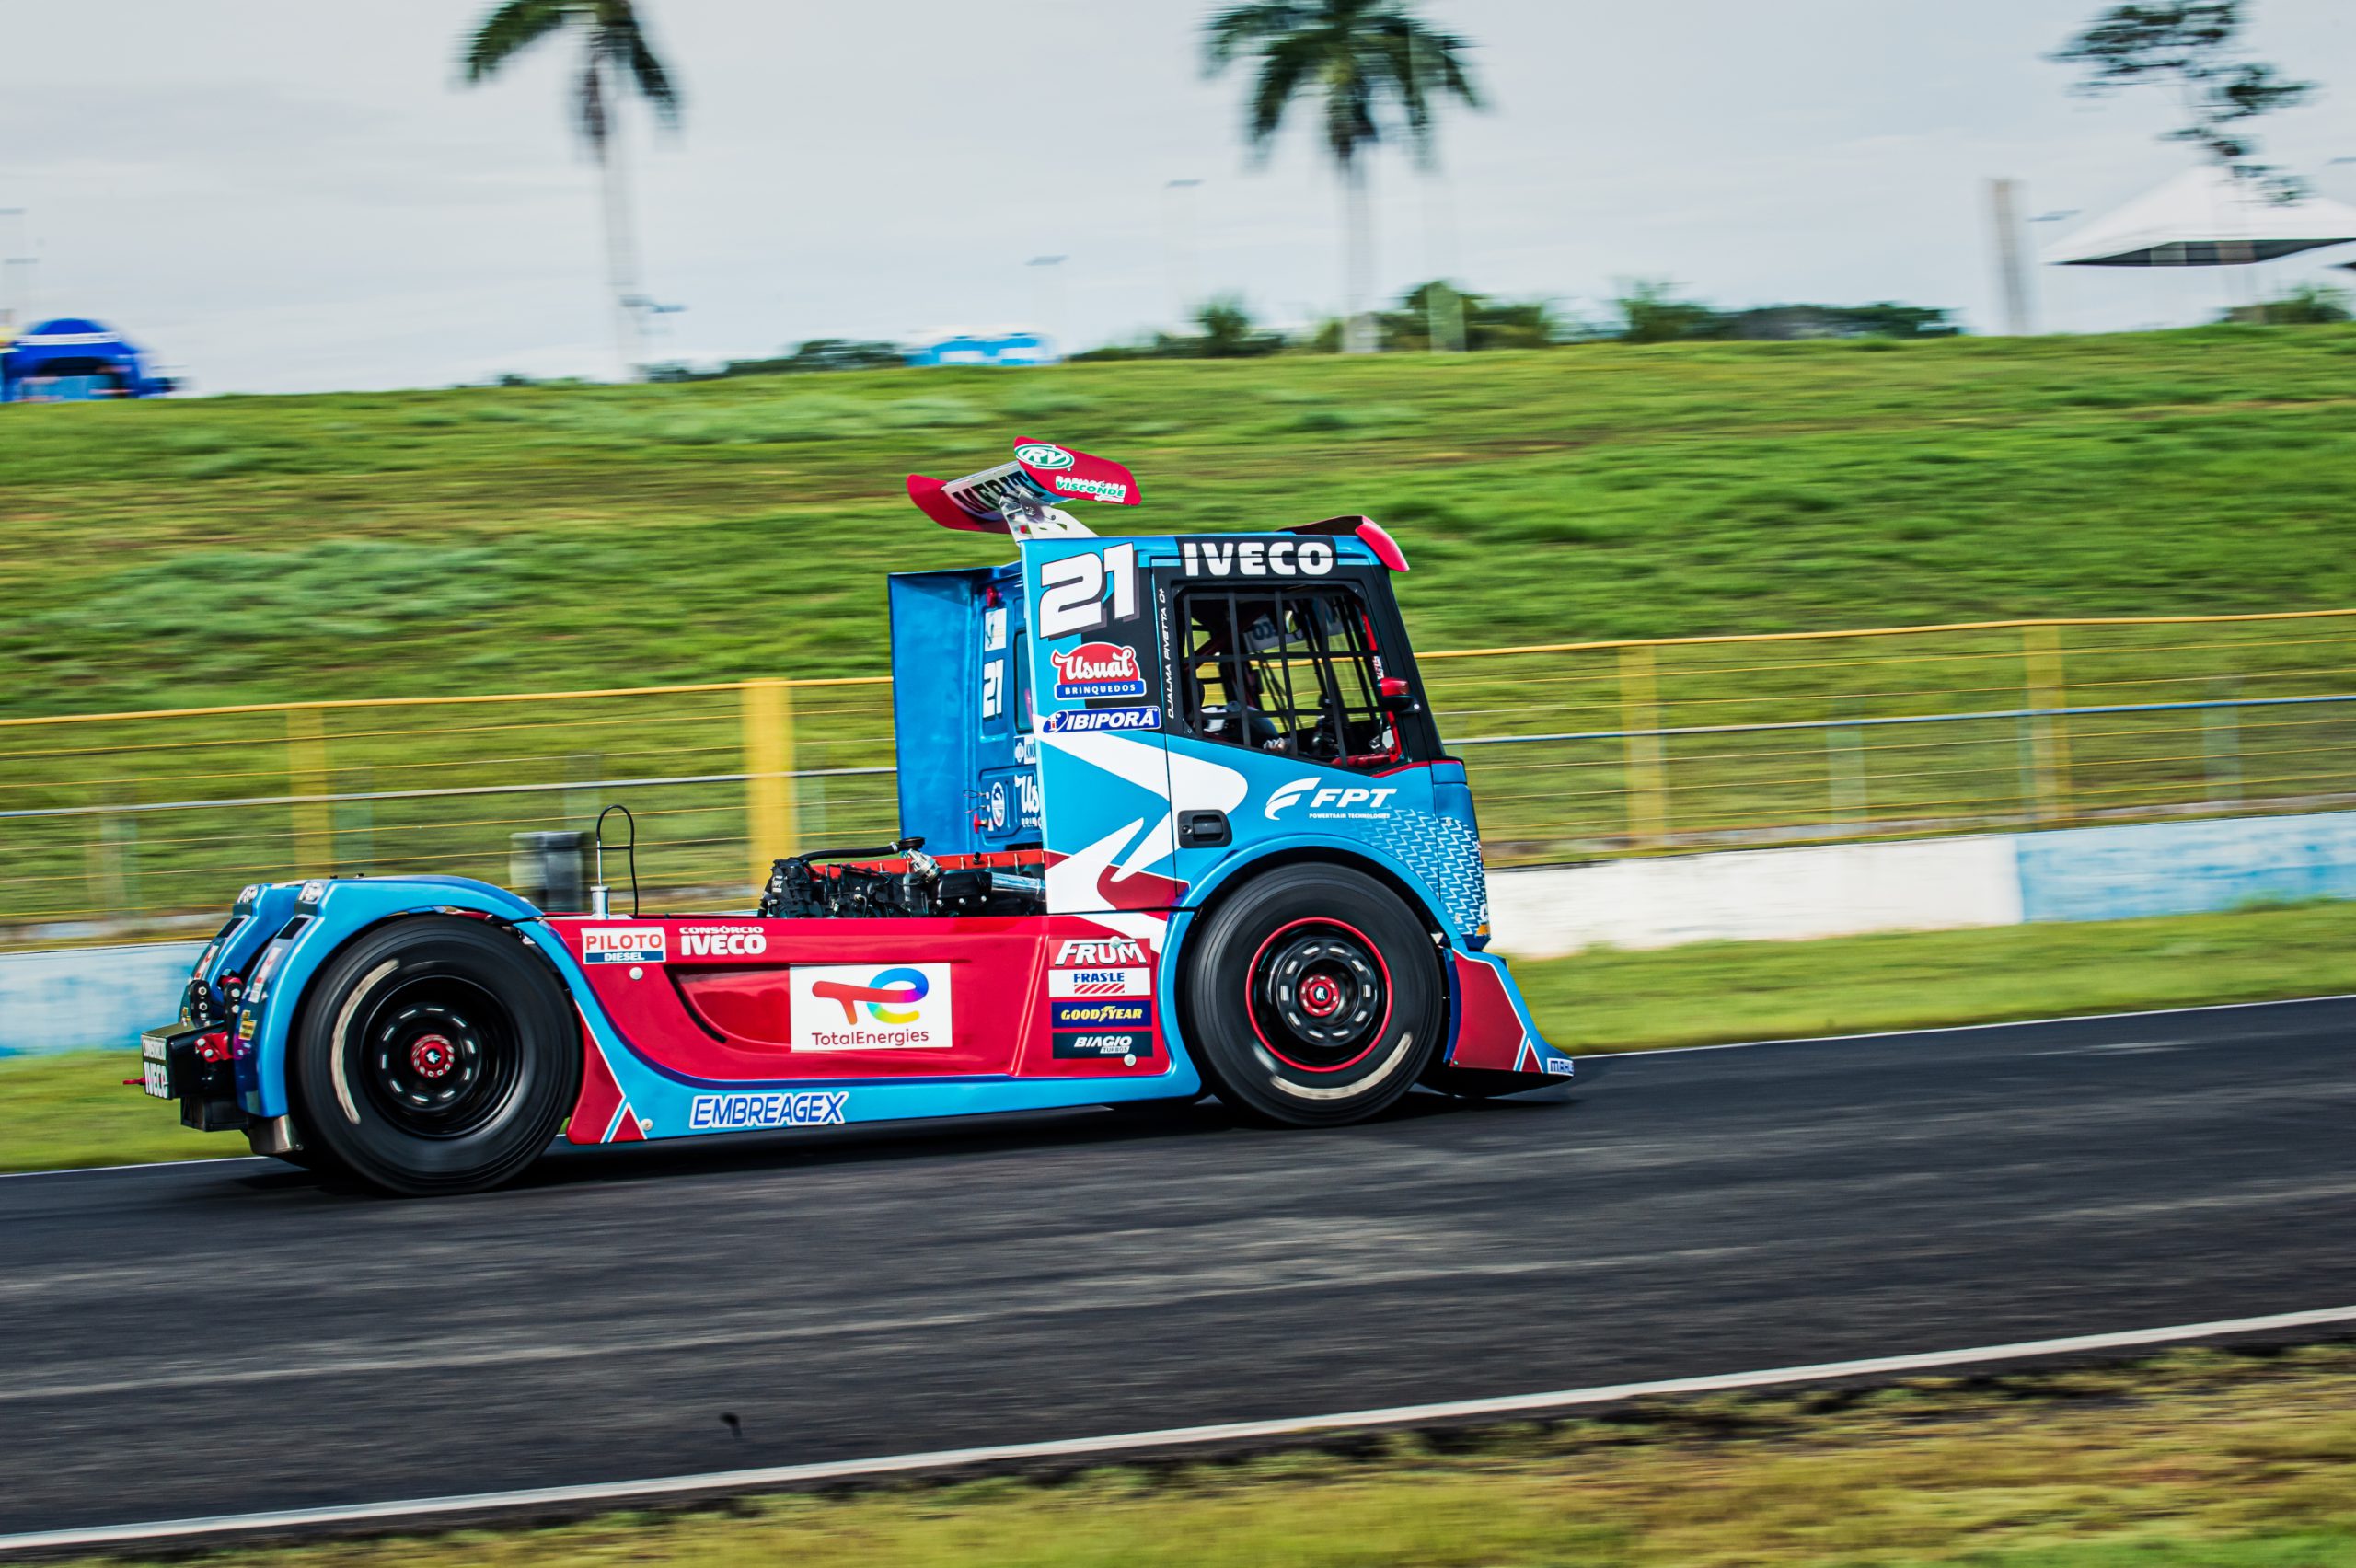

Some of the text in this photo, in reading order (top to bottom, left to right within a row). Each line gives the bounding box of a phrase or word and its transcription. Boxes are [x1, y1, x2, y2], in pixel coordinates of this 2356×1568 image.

[1022, 448, 1068, 465] RV
[952, 470, 1047, 515] MERIT
[1056, 480, 1126, 497] VISCONDE
[1184, 541, 1334, 577] IVECO
[1039, 541, 1135, 639] 21
[1160, 607, 1171, 661] PIVETTA
[1054, 649, 1134, 681] Usual
[982, 658, 1004, 719] 21
[1064, 684, 1137, 696] BRINQUEDOS
[1164, 663, 1175, 719] DJALMA
[1309, 788, 1398, 808] FPT
[679, 925, 765, 935] CONSÓRCIO
[585, 933, 664, 951] PILOTO
[680, 934, 767, 956] IVECO
[1055, 939, 1147, 966] FRUM
[604, 951, 645, 962] DIESEL
[1060, 1007, 1143, 1021] GOODYEAR
[812, 1028, 930, 1046] TotalEnergies
[1073, 1036, 1133, 1048] BIAGIO
[693, 1093, 847, 1126] EMBREAGEX
